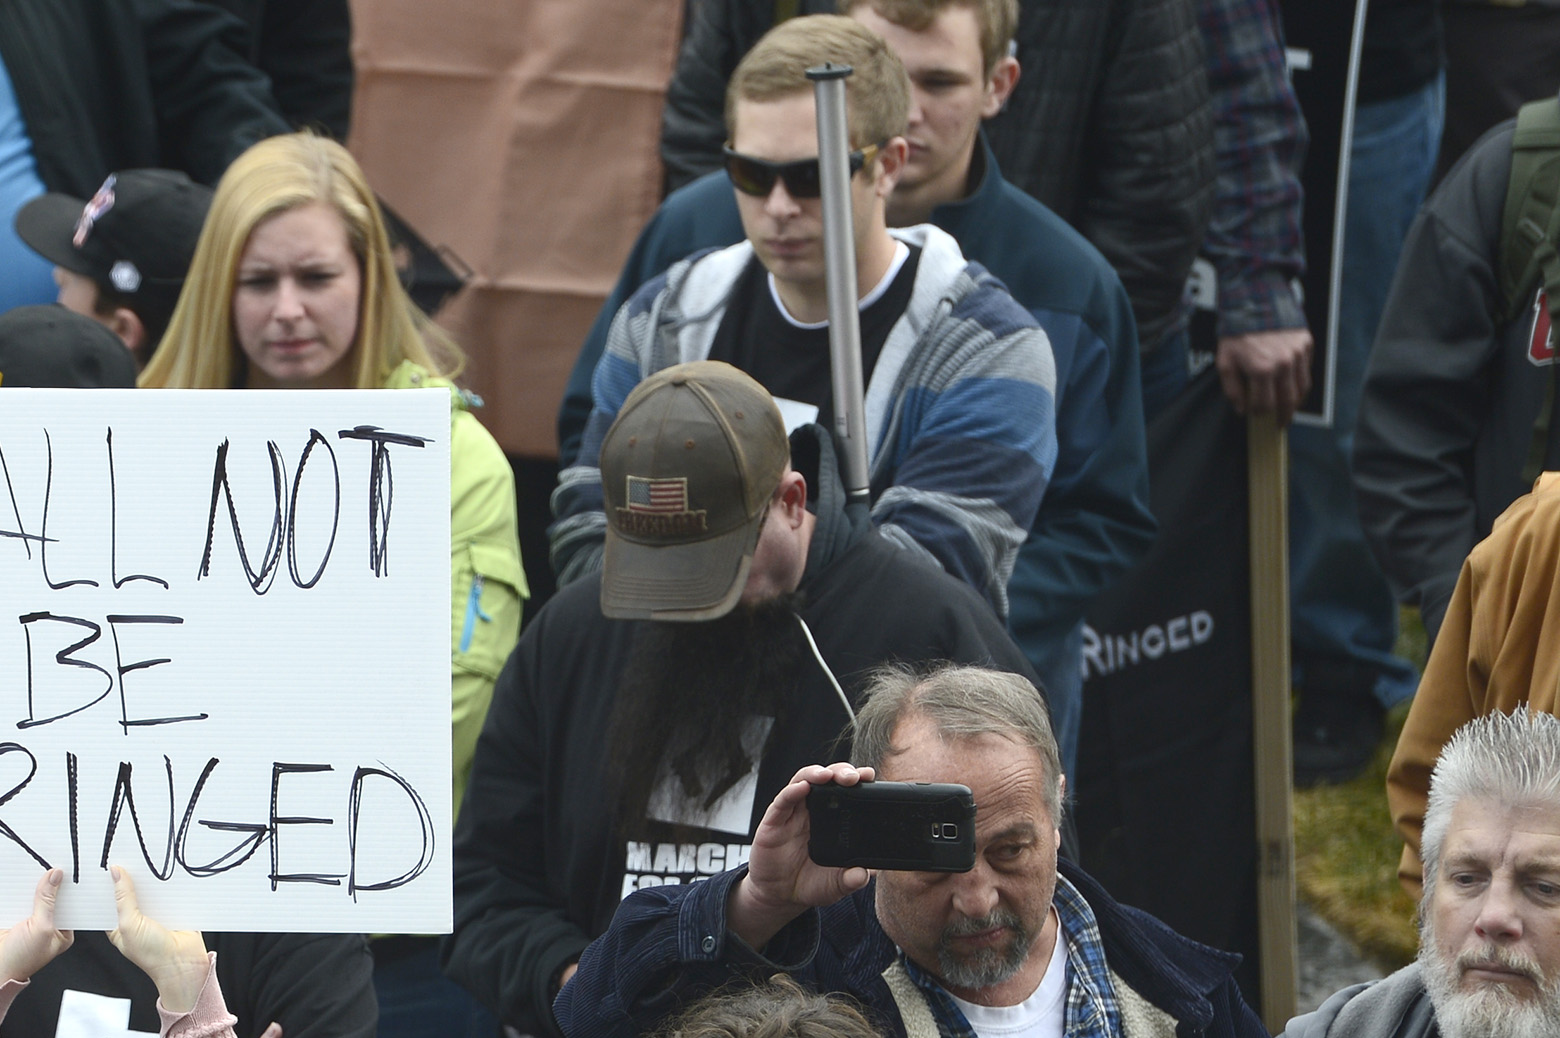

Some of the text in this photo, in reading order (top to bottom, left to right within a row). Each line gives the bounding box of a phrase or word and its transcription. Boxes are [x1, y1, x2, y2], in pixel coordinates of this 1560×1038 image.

[198, 425, 435, 595] NOT
[16, 611, 208, 735] BE
[1081, 610, 1215, 682] RINGED
